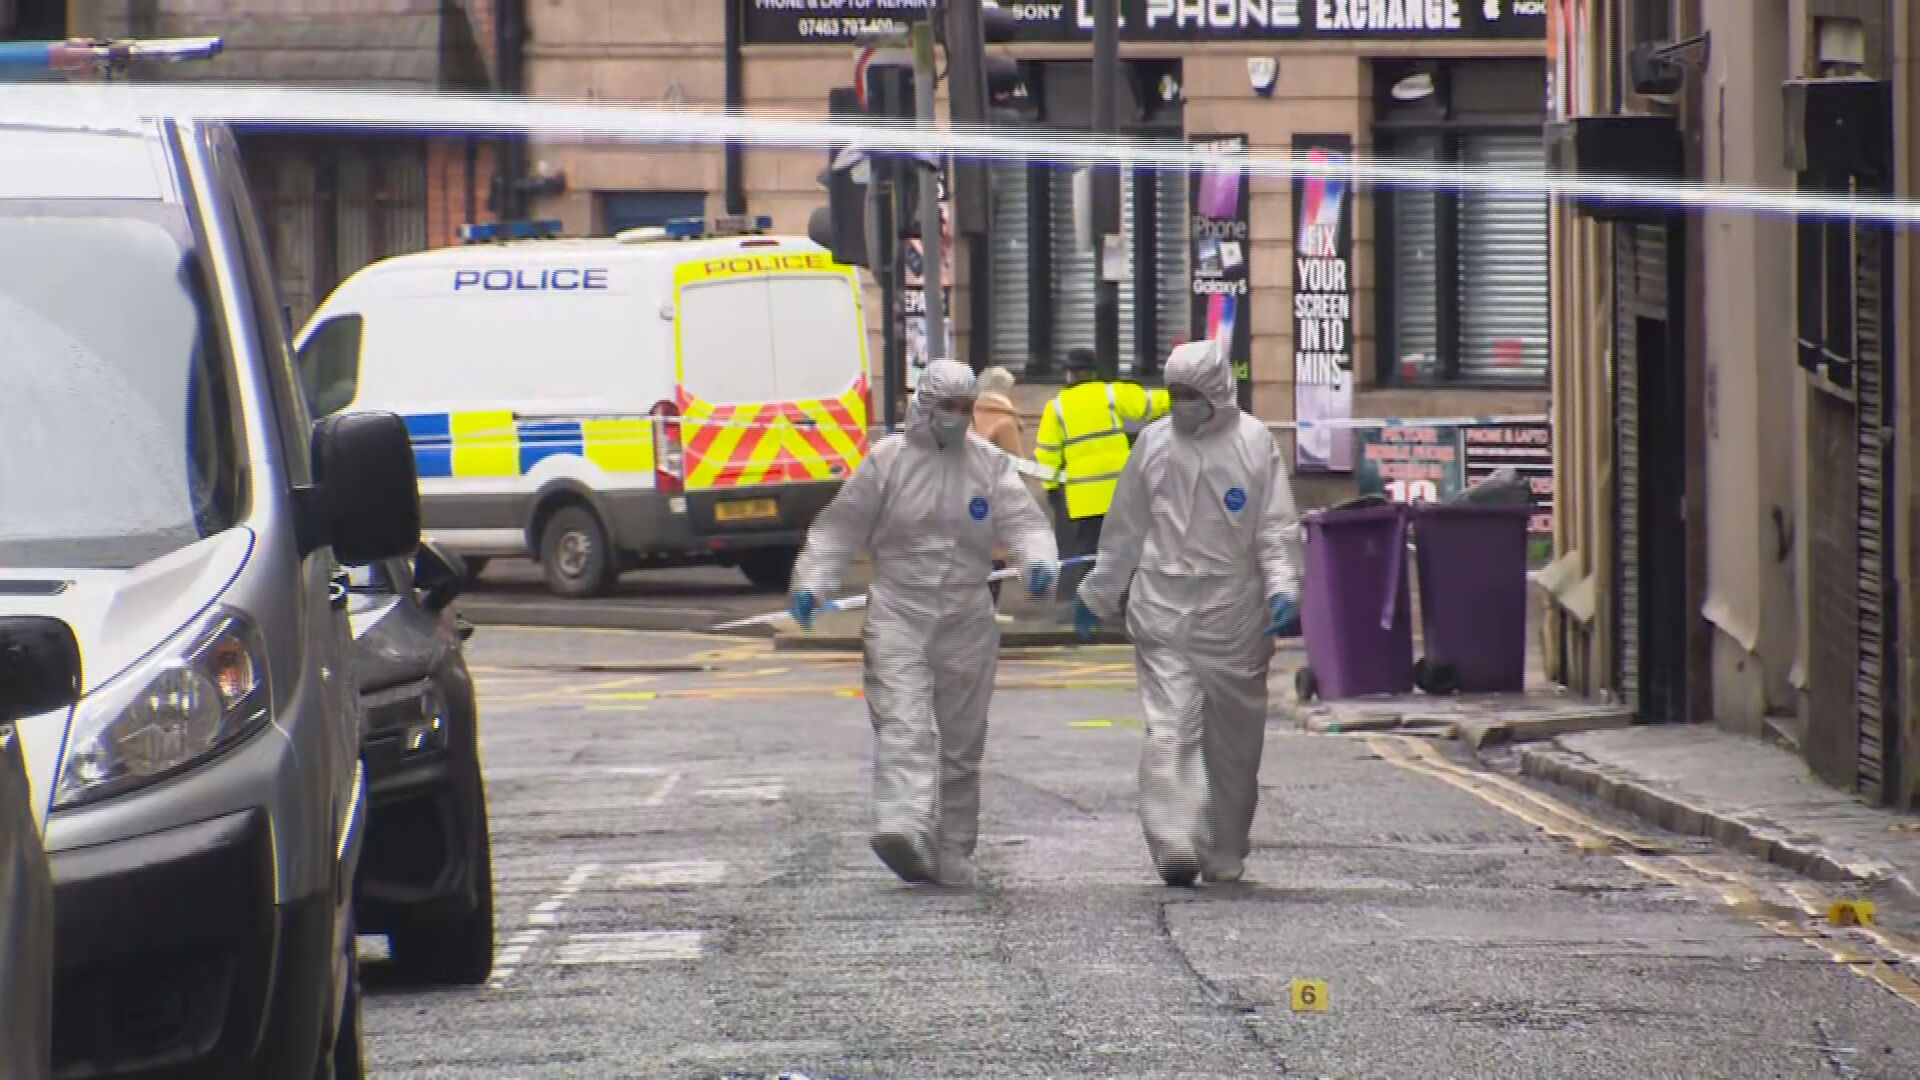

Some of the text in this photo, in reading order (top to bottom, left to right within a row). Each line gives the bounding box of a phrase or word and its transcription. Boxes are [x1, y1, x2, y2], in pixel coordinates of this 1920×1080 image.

[1146, 0, 1300, 28] PHONE
[1316, 0, 1462, 30] EXCHANGE
[1192, 216, 1246, 239] iPhone
[1307, 225, 1336, 257] FIX
[703, 254, 826, 275] POLICE
[1297, 258, 1347, 291] YOUR
[454, 268, 608, 291] POLICE
[1295, 294, 1350, 319] SCREEN
[1301, 319, 1344, 351] IN 10
[1383, 479, 1438, 505] 10
[1301, 984, 1317, 1005] 6
